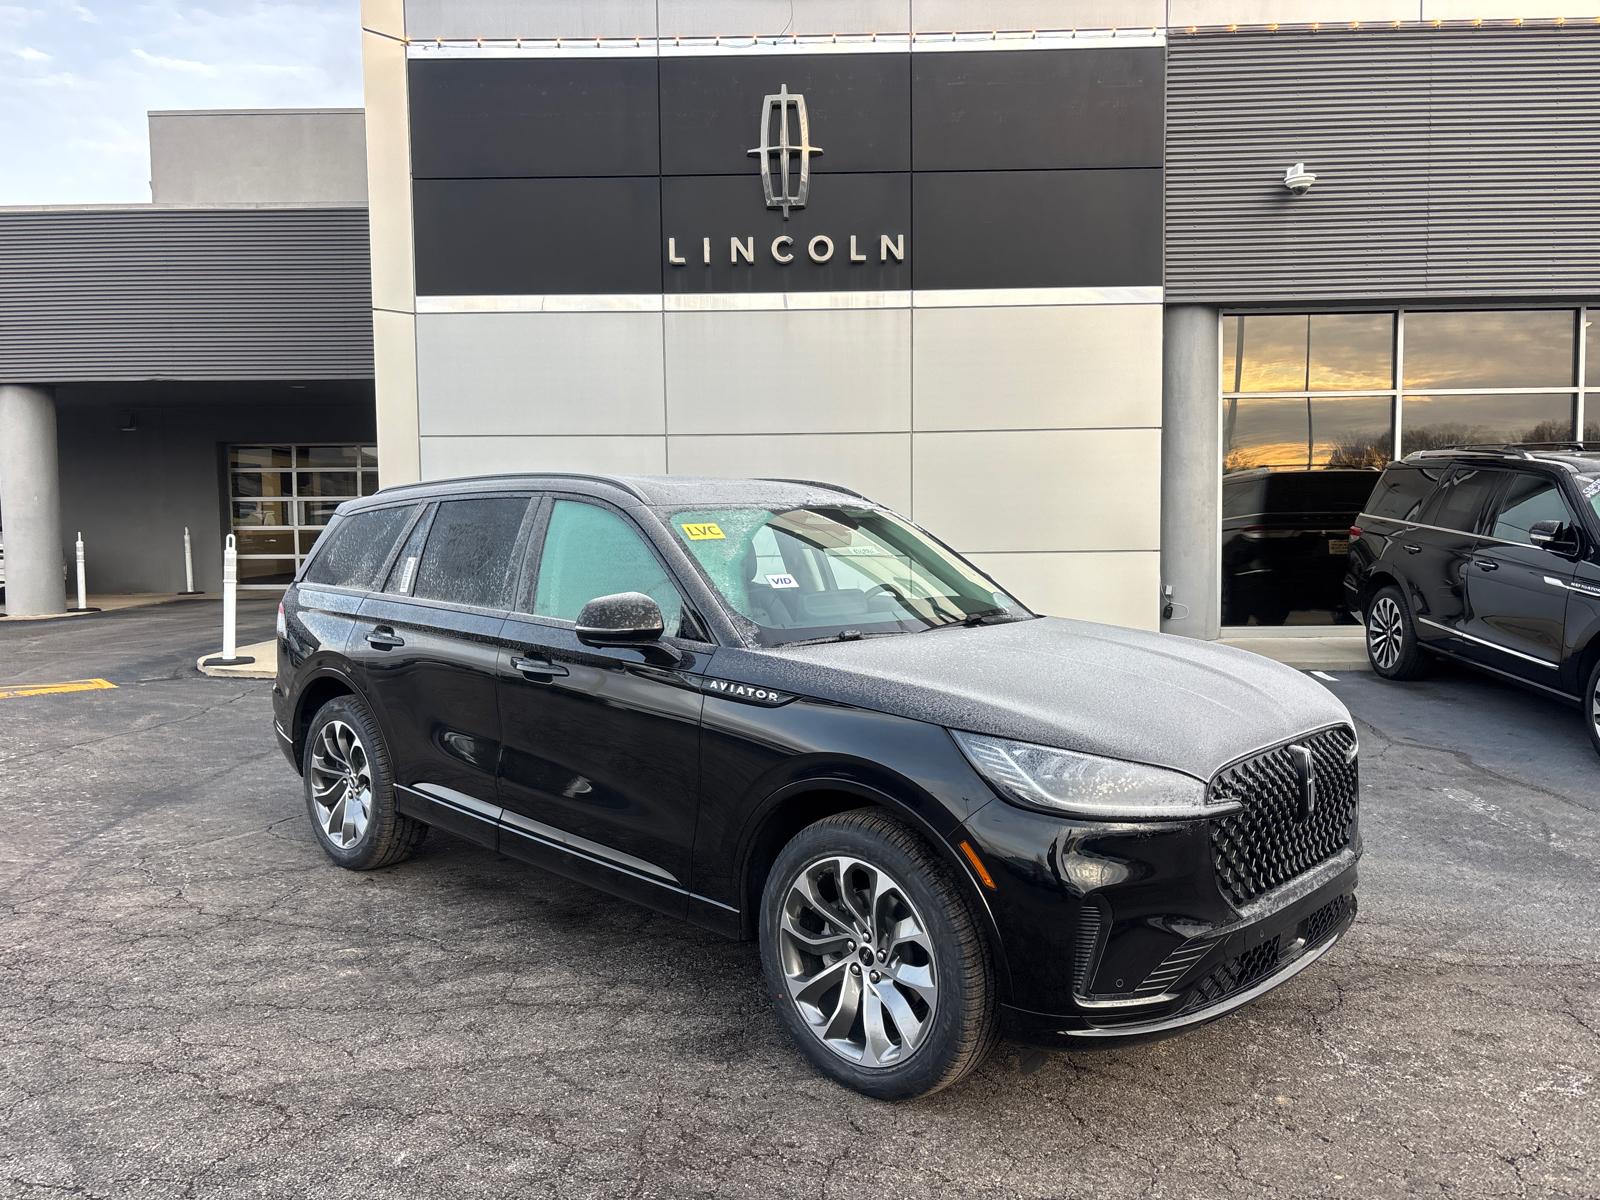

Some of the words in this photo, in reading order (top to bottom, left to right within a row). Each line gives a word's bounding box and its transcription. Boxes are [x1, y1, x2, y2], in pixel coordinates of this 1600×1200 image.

[668, 234, 904, 266] LINCOLN
[686, 525, 721, 537] LVC
[771, 577, 792, 585] VID
[709, 680, 779, 702] AVIATOR
